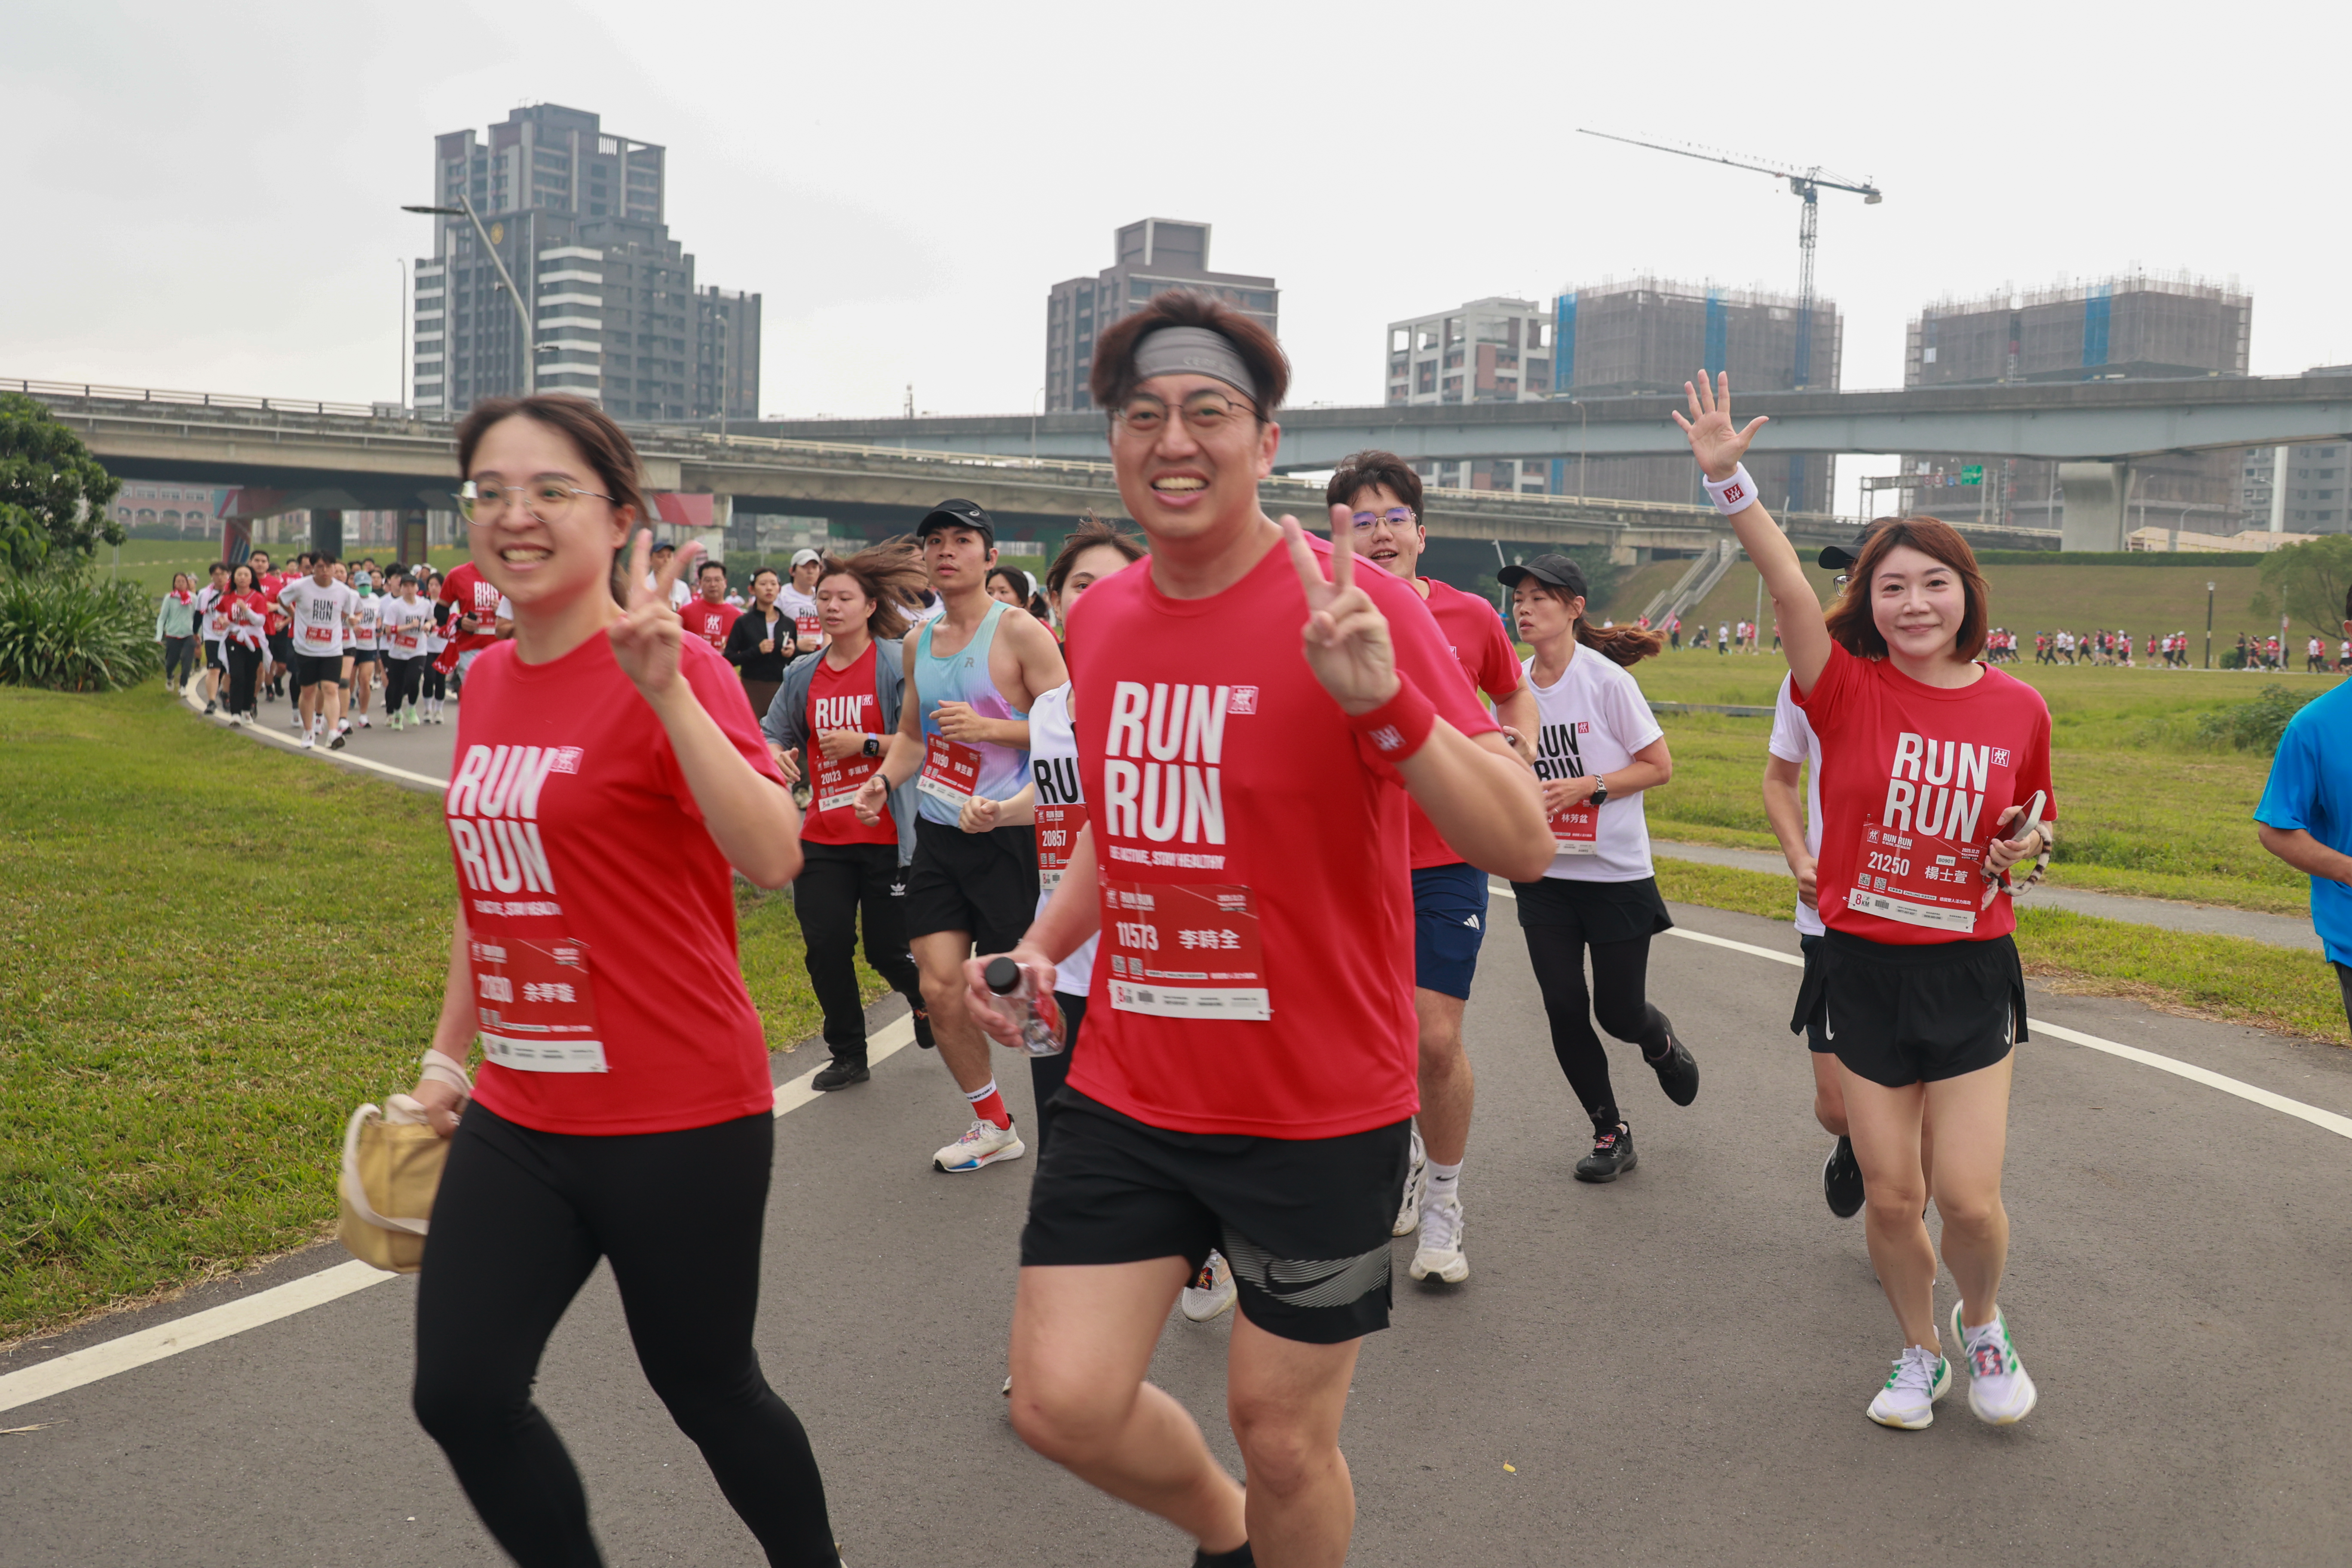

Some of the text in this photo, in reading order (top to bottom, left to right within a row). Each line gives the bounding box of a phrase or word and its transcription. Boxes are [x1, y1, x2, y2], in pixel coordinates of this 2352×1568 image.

[313, 599, 333, 610] RUN
[815, 695, 862, 728] RUN
[1105, 681, 1230, 764] RUN
[821, 769, 842, 785] 20123
[1891, 732, 1990, 792] RUN
[447, 744, 559, 820] RUN
[1033, 757, 1079, 804] RU
[1104, 759, 1226, 845] RUN
[1883, 778, 1984, 843] RUN
[1042, 830, 1066, 847] 20857
[1883, 833, 1913, 847] RUN RUN
[448, 818, 557, 895] RUN
[1868, 851, 1910, 876] 21250
[1924, 865, 1969, 884] 楊士萱
[1855, 894, 1862, 905] 8
[1116, 921, 1159, 951] 11573
